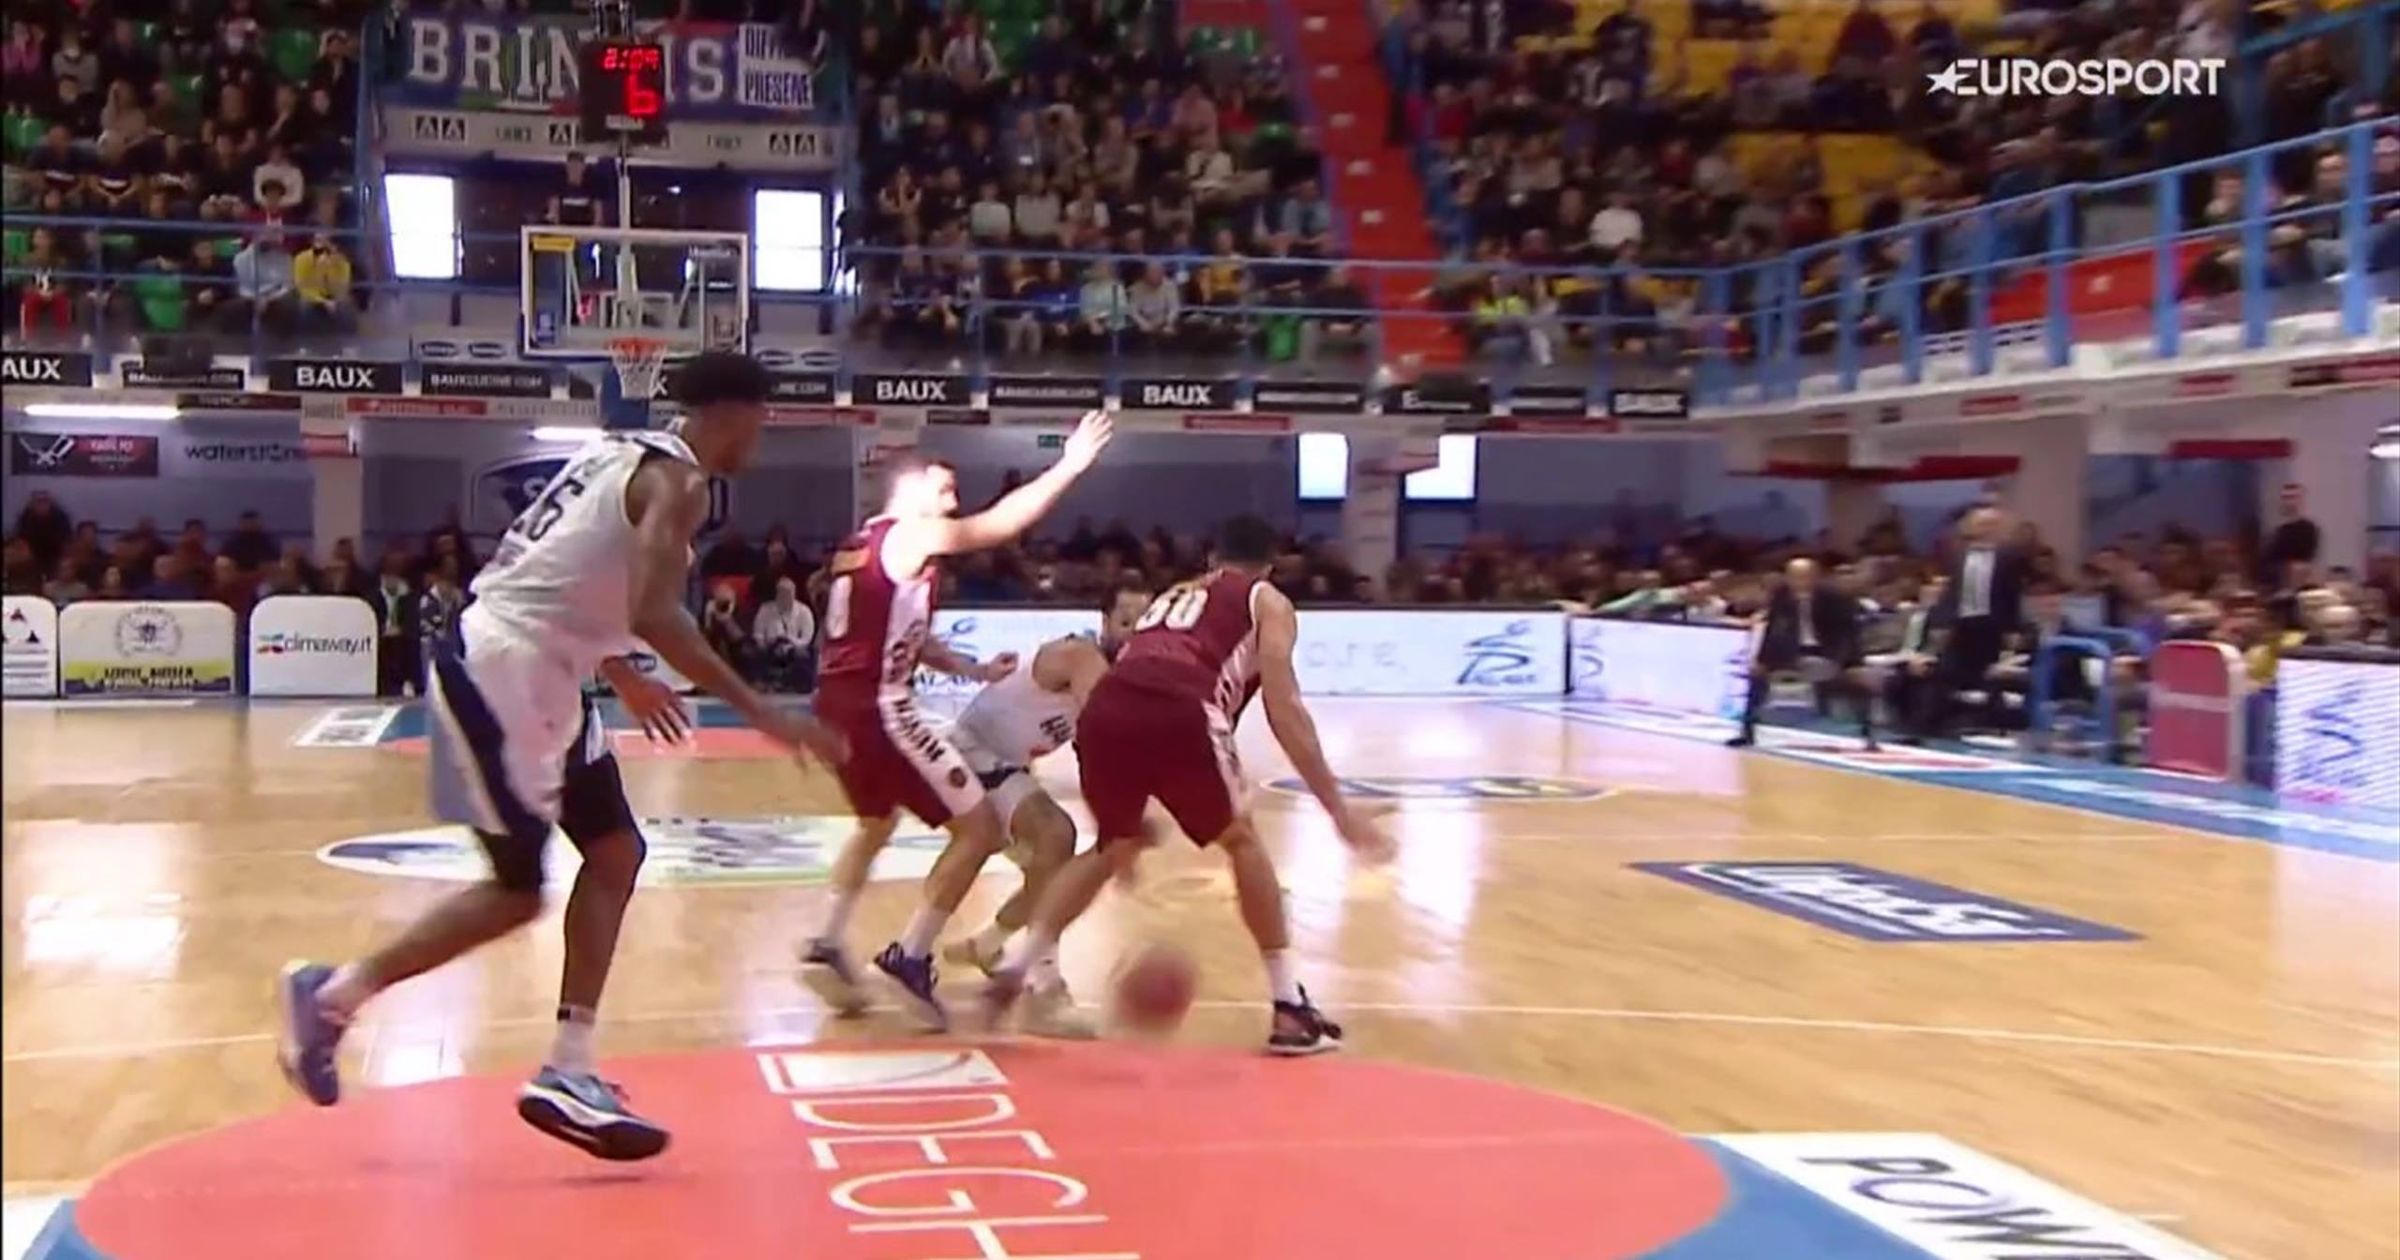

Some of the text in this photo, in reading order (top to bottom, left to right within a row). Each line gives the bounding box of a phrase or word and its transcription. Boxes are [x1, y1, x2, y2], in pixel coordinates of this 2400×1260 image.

[2, 358, 61, 381] AUX
[296, 366, 376, 389] BAUX
[875, 379, 948, 402] BAUX
[1142, 384, 1213, 405] BAUX
[1797, 1156, 2156, 1260] POW
